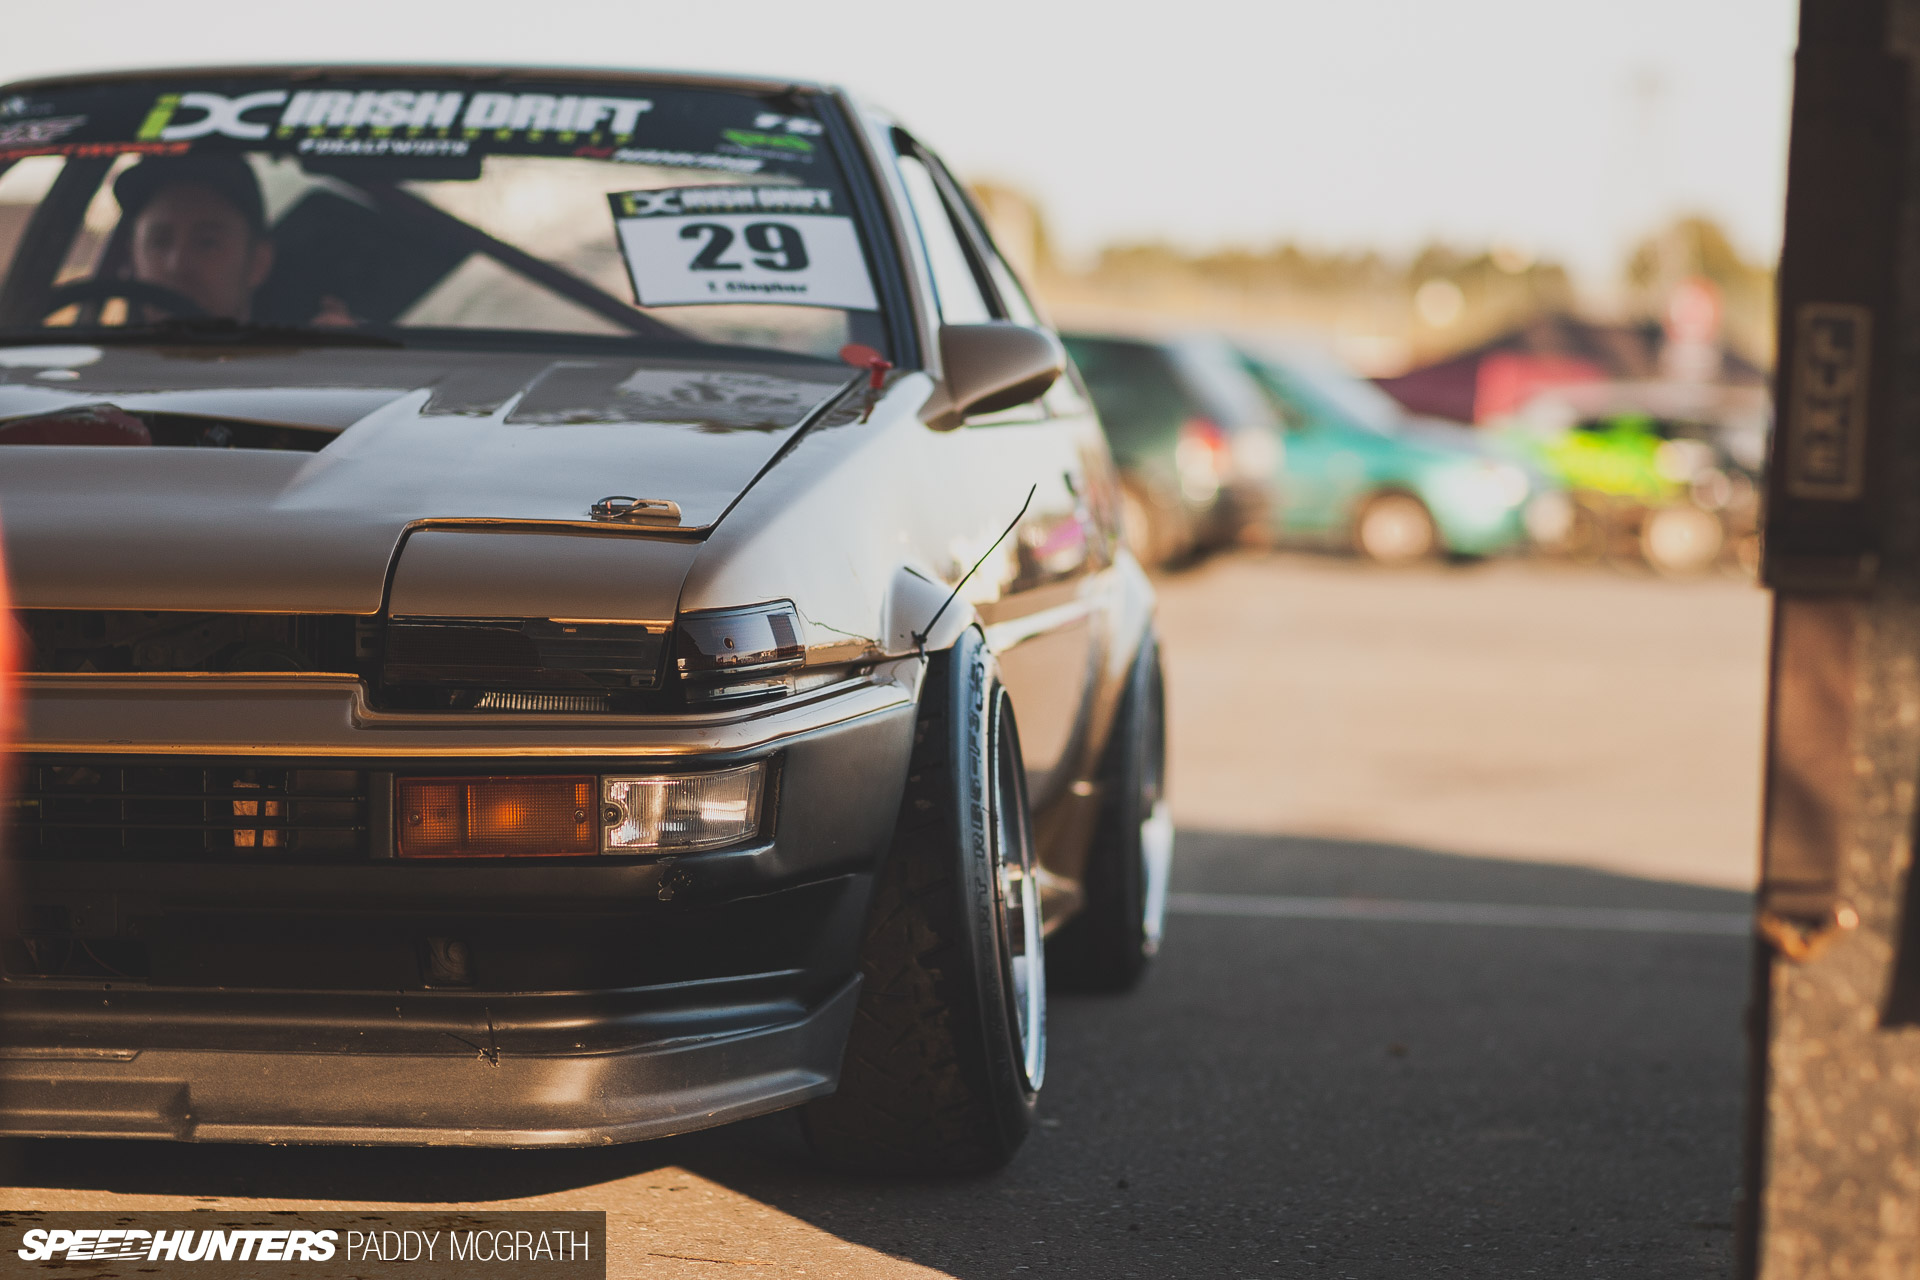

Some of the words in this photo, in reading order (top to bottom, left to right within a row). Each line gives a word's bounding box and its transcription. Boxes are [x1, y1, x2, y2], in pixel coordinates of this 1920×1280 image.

[281, 91, 464, 127] IRISH
[462, 92, 654, 135] DRIFT
[679, 221, 811, 273] 29
